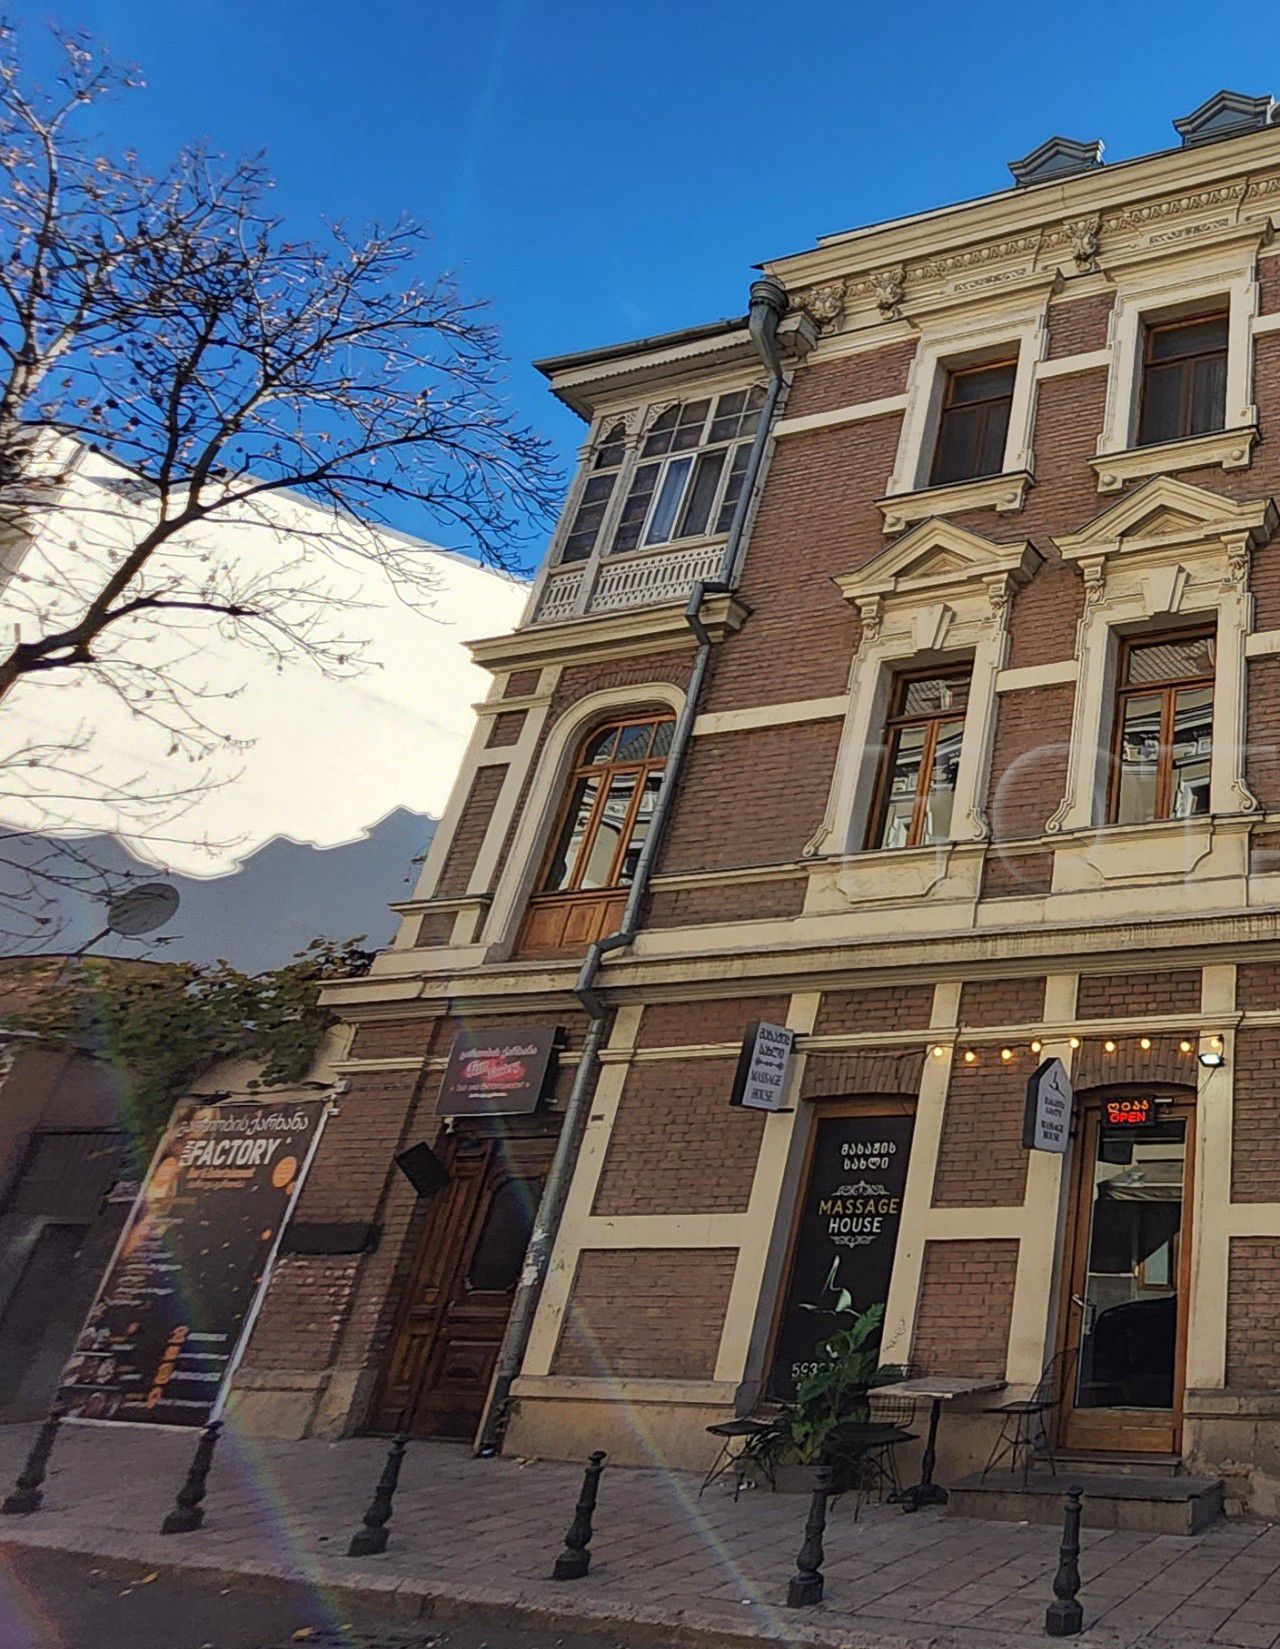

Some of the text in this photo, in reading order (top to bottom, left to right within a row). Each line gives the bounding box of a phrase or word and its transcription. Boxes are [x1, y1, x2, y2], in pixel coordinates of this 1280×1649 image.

[750, 1070, 781, 1086] MASSAGE
[751, 1088, 773, 1102] HOUSE
[1109, 1112, 1146, 1123] OPEN
[188, 1138, 283, 1166] FACTORY
[818, 1198, 900, 1216] MASSAGE
[828, 1217, 884, 1234] HOUSE
